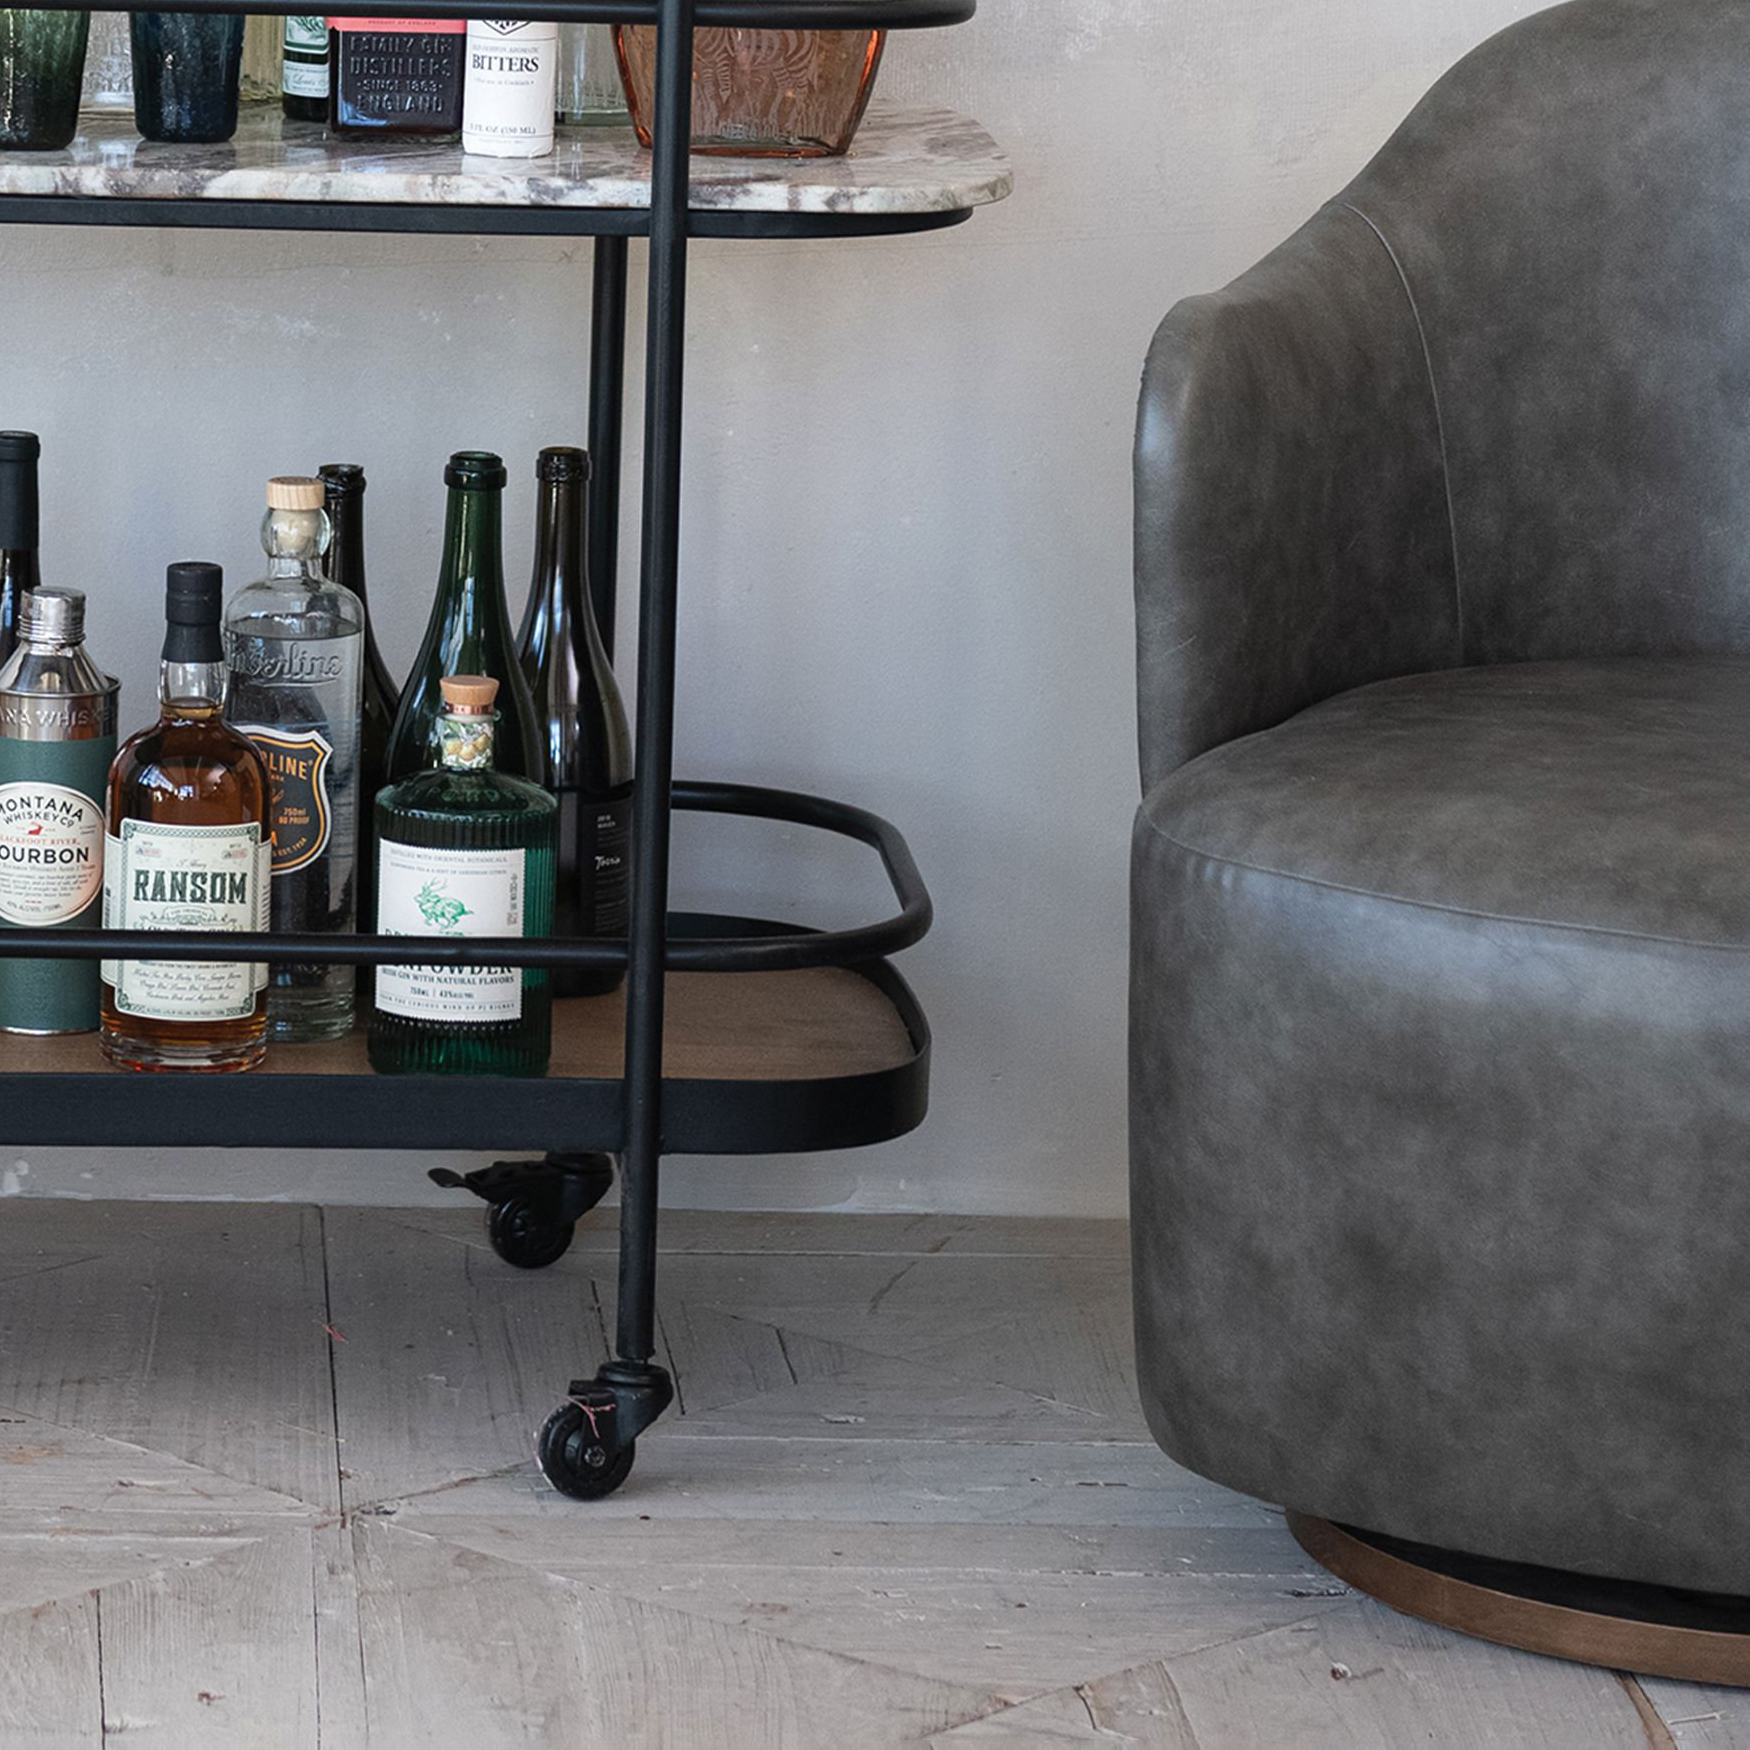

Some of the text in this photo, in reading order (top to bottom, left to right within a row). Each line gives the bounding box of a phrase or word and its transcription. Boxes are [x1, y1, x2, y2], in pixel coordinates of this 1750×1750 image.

[350, 56, 452, 77] DISTILLERS
[472, 53, 540, 73] BITTERS
[356, 94, 444, 114] ENGLAND
[3, 811, 59, 825] WHISKEY
[289, 816, 310, 824] PROOF
[133, 868, 248, 905] RANSOM
[398, 970, 410, 980] GIN
[412, 973, 435, 983] WITH
[437, 976, 477, 986] NATURAL
[479, 976, 515, 986] FLAVORS
